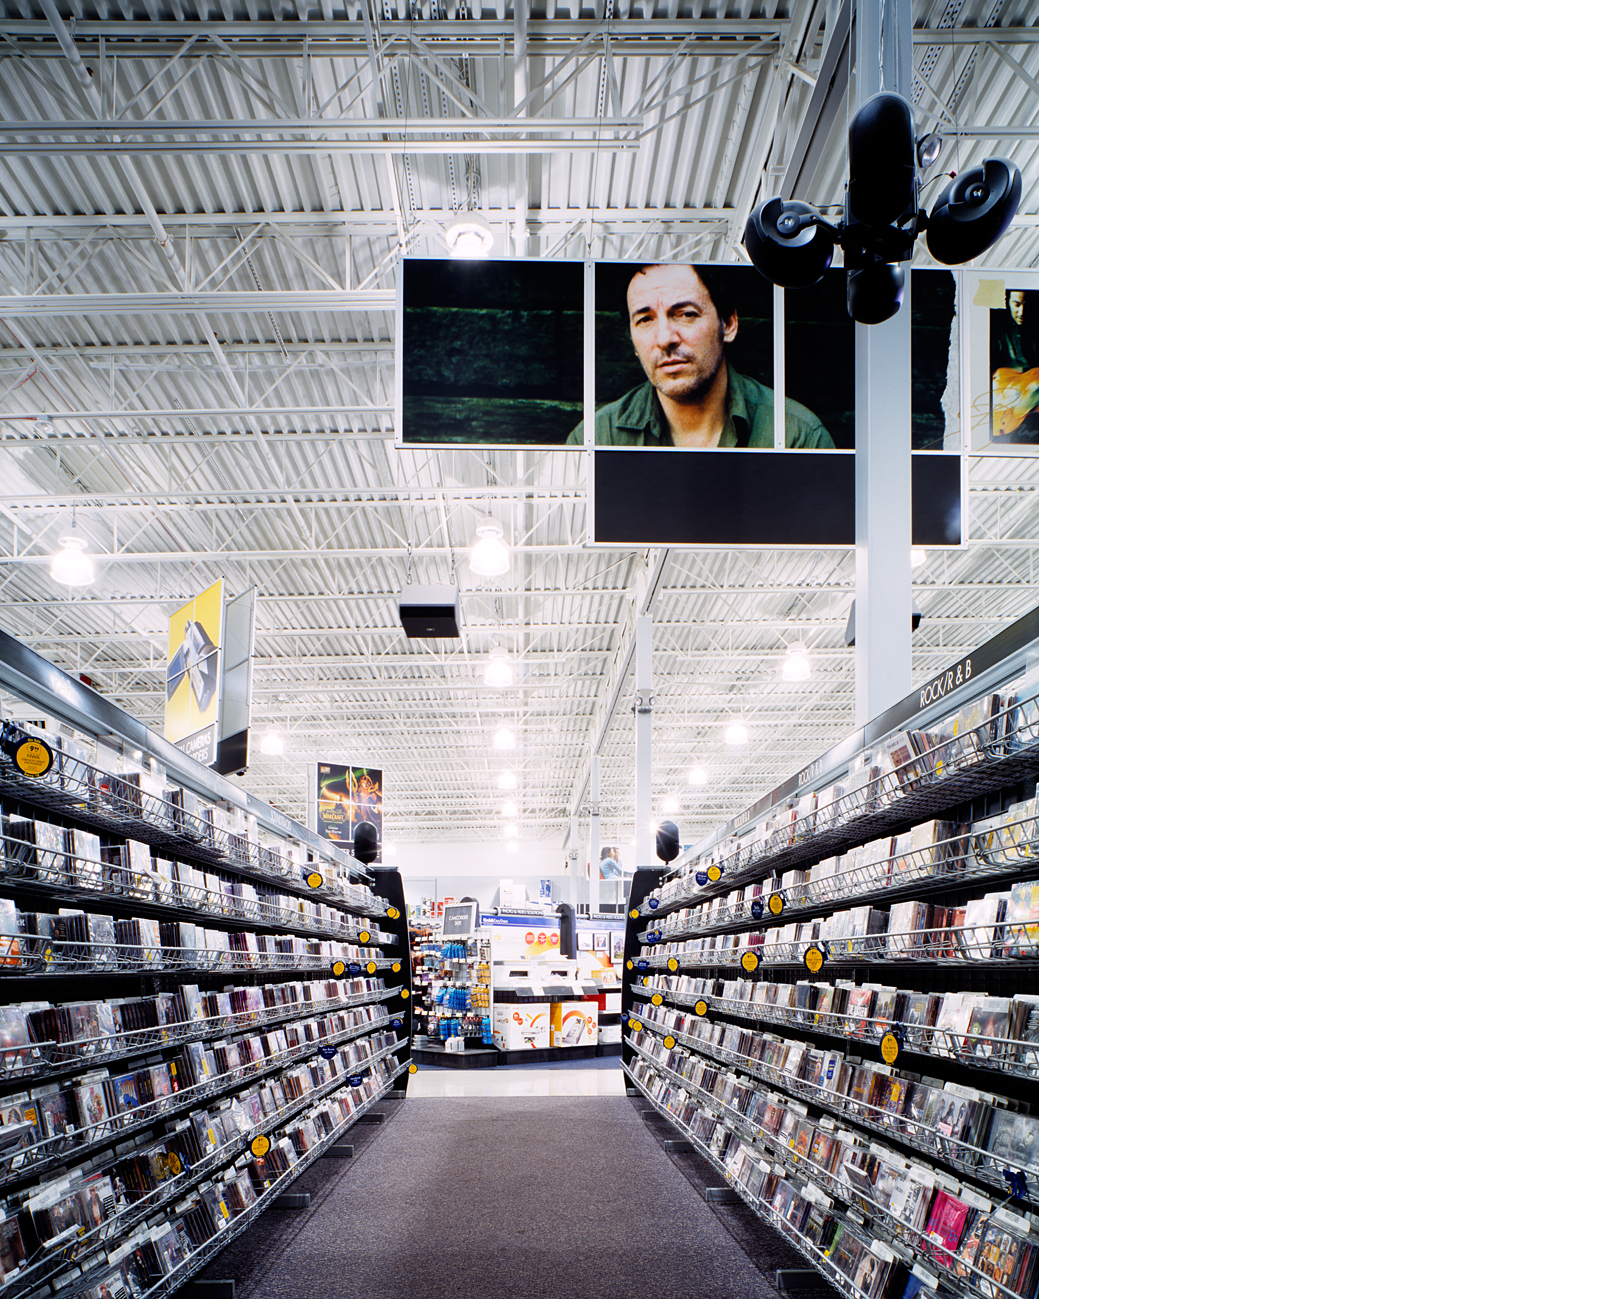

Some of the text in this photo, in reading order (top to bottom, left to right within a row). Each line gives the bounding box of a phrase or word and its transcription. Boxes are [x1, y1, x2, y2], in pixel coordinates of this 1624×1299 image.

[920, 659, 972, 708] ROCK/R & B
